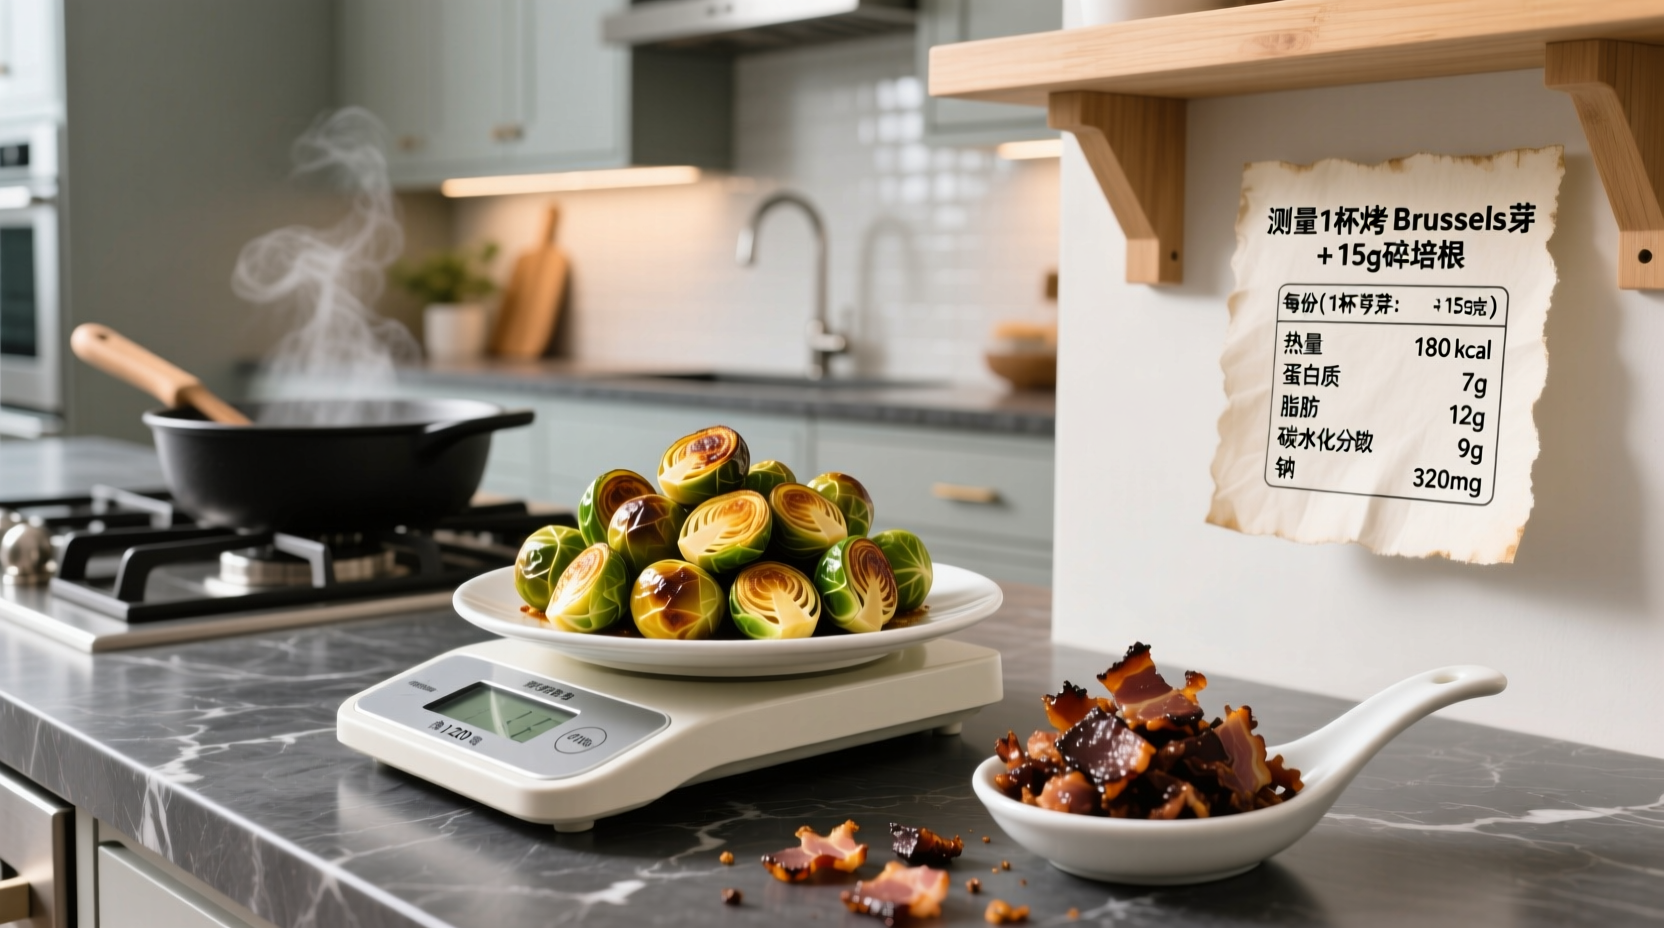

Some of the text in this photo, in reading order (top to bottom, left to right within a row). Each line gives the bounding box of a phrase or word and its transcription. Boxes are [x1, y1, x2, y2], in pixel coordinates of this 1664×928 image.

[1283, 330, 1492, 360] 热量 180 kcal
[1282, 363, 1488, 399] 蛋白质 7g
[1280, 394, 1486, 432] 脂肪 12g
[1457, 437, 1484, 466] 9g
[1274, 455, 1482, 498] 钠 320mg
